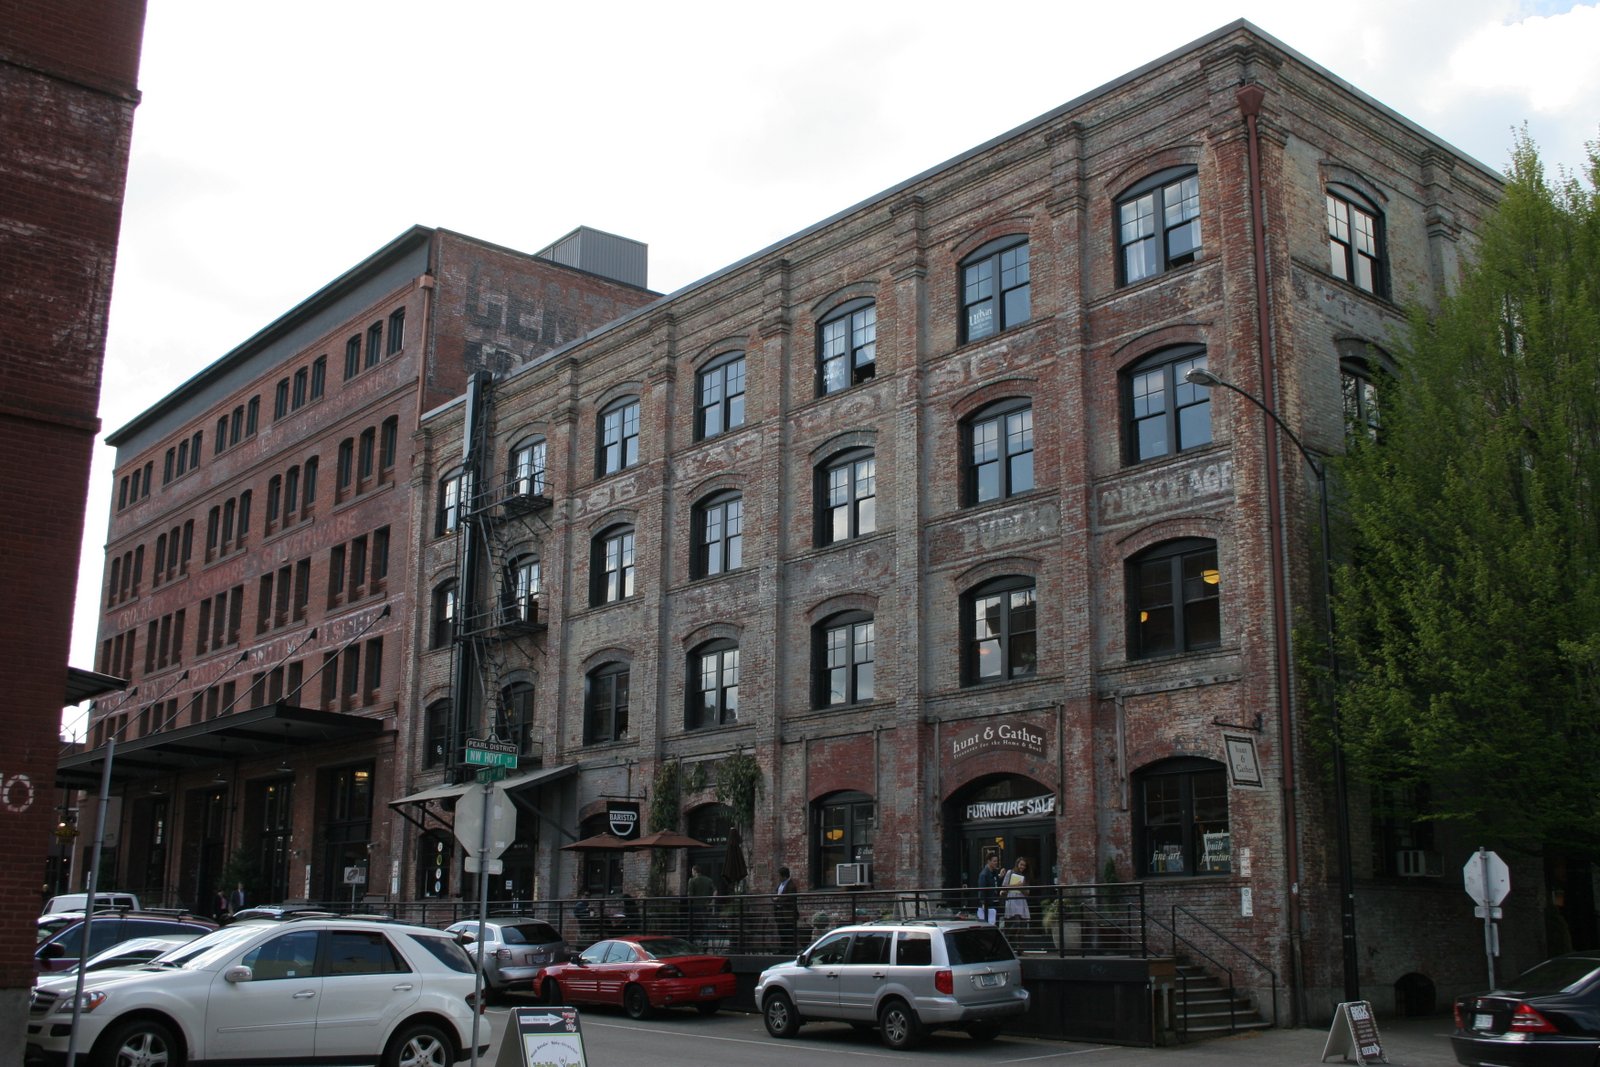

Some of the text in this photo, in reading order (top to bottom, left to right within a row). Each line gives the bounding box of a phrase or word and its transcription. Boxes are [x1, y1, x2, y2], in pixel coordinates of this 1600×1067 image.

[953, 724, 1043, 754] hunt & Gather
[1002, 739, 1019, 747] Home
[468, 740, 517, 753] PEARL DISTRICT
[470, 750, 482, 761] NW
[484, 753, 502, 764] HOYT
[966, 795, 1056, 819] FURNITURE SALE
[609, 813, 634, 821] BARISTA
[1150, 849, 1181, 865] fine art
